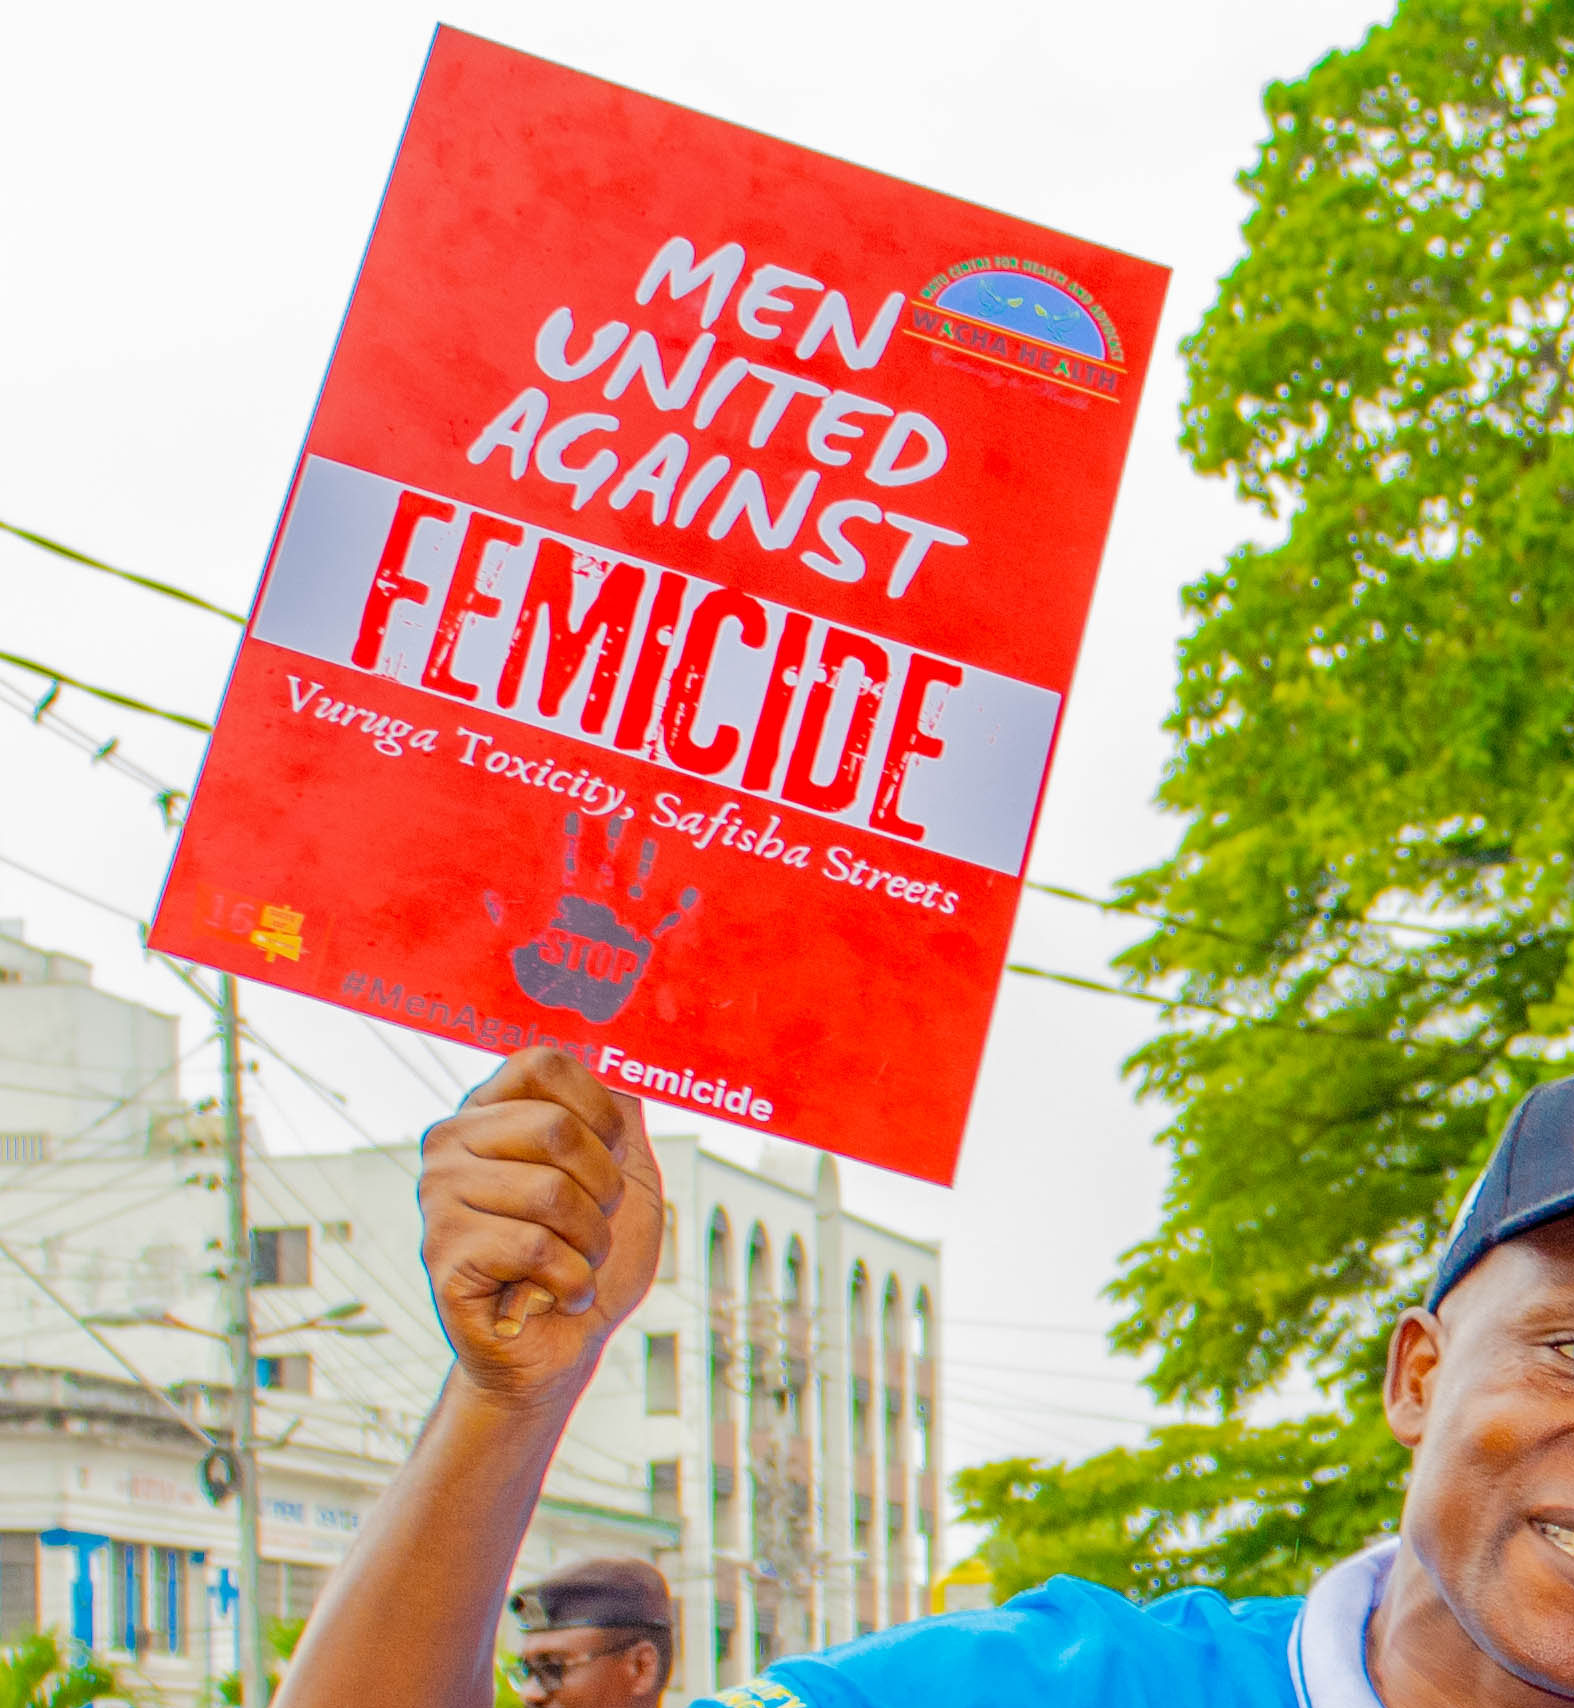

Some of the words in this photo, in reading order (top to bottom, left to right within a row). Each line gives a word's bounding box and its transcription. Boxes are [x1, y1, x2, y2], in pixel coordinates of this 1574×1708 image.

[635, 236, 906, 371] MEN
[912, 307, 1008, 357] WACHA
[1017, 343, 1117, 392] HEALTH
[948, 256, 992, 277] CENTRE
[993, 256, 1019, 268] FOR
[1021, 257, 1069, 285] HEALTH
[1066, 282, 1095, 304] AND
[534, 306, 949, 487] UNITED
[466, 387, 969, 600] AGAINST
[350, 489, 964, 844] FEMICIDE
[285, 675, 439, 757] Vuruga
[456, 726, 635, 821] Toxicity,
[650, 791, 809, 868] Safisha
[821, 847, 960, 915] Streets
[537, 929, 641, 984] STOP
